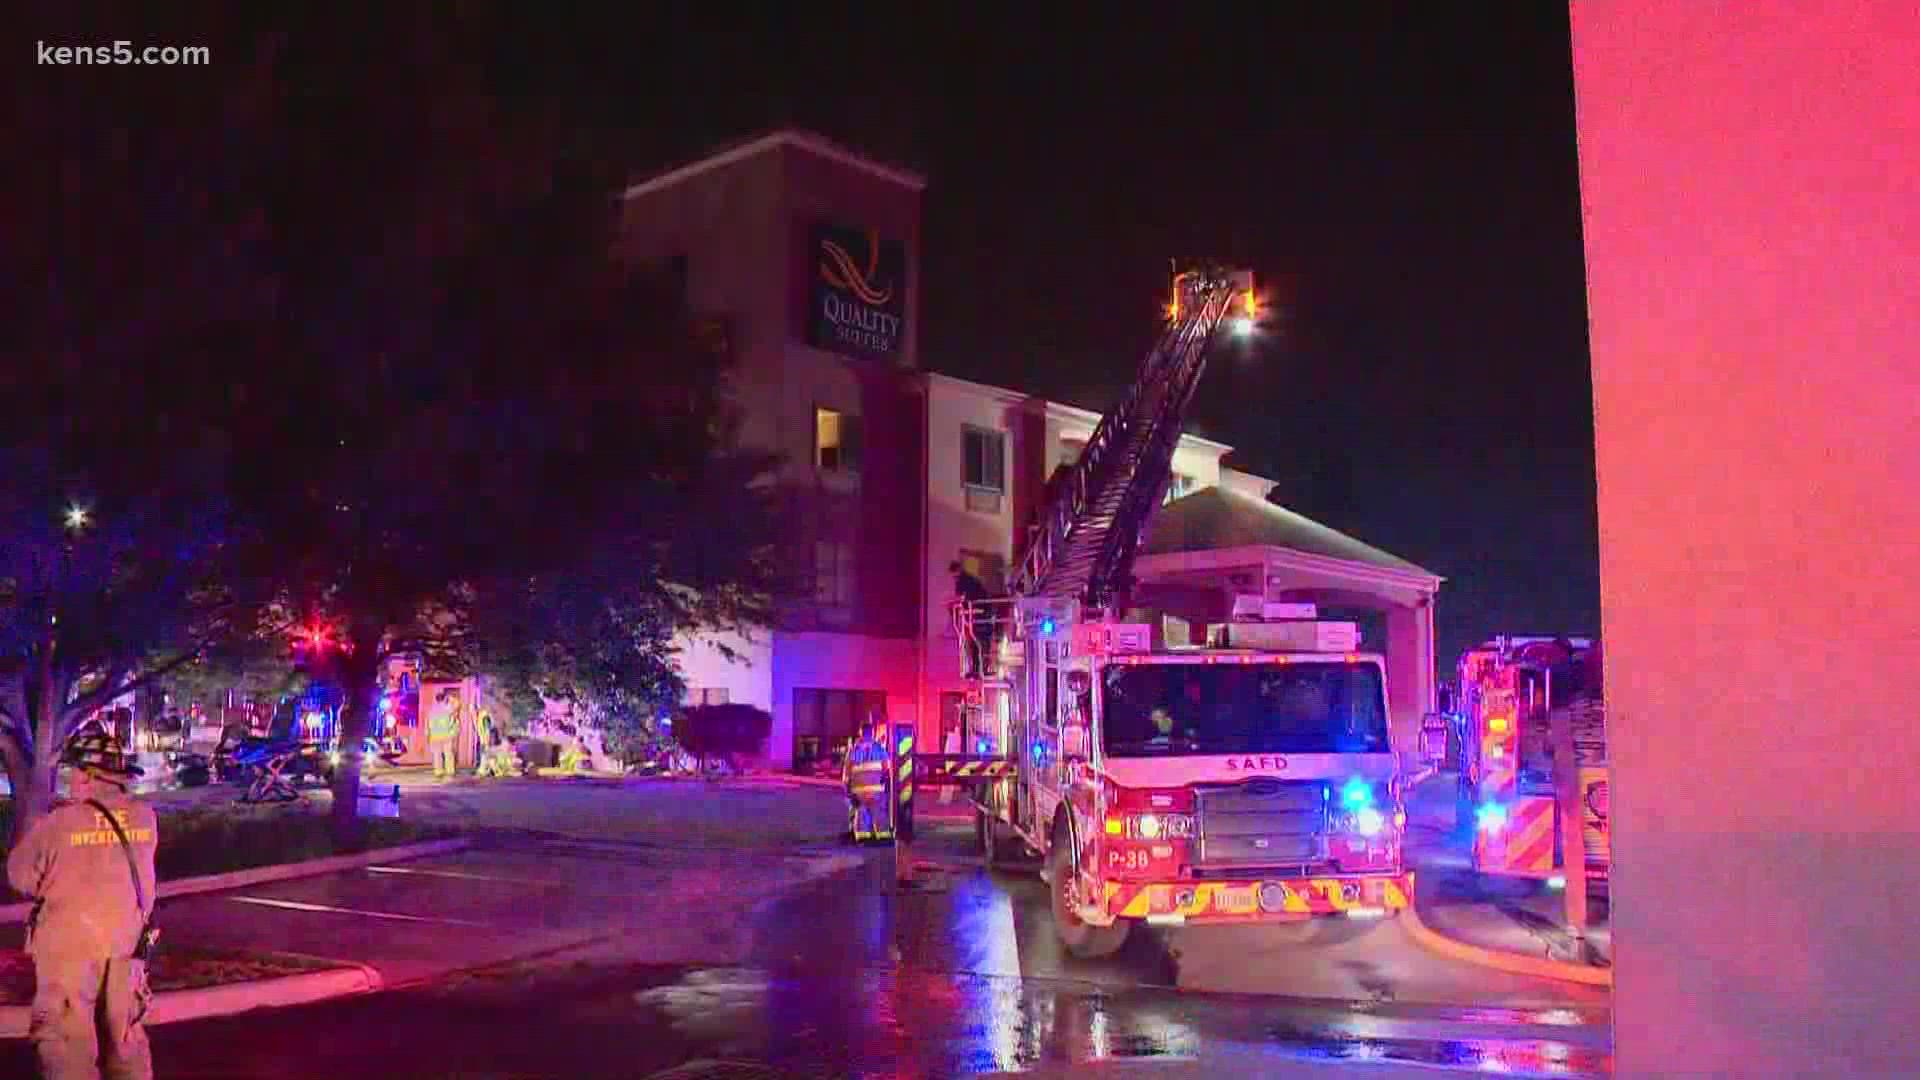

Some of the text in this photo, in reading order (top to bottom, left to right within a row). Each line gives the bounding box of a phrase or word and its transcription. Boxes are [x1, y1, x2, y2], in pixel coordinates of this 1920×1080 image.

[823, 294, 901, 337] QUALITY
[1226, 757, 1289, 771] SAFD
[94, 810, 129, 829] FIE
[1109, 849, 1149, 870] P-38
